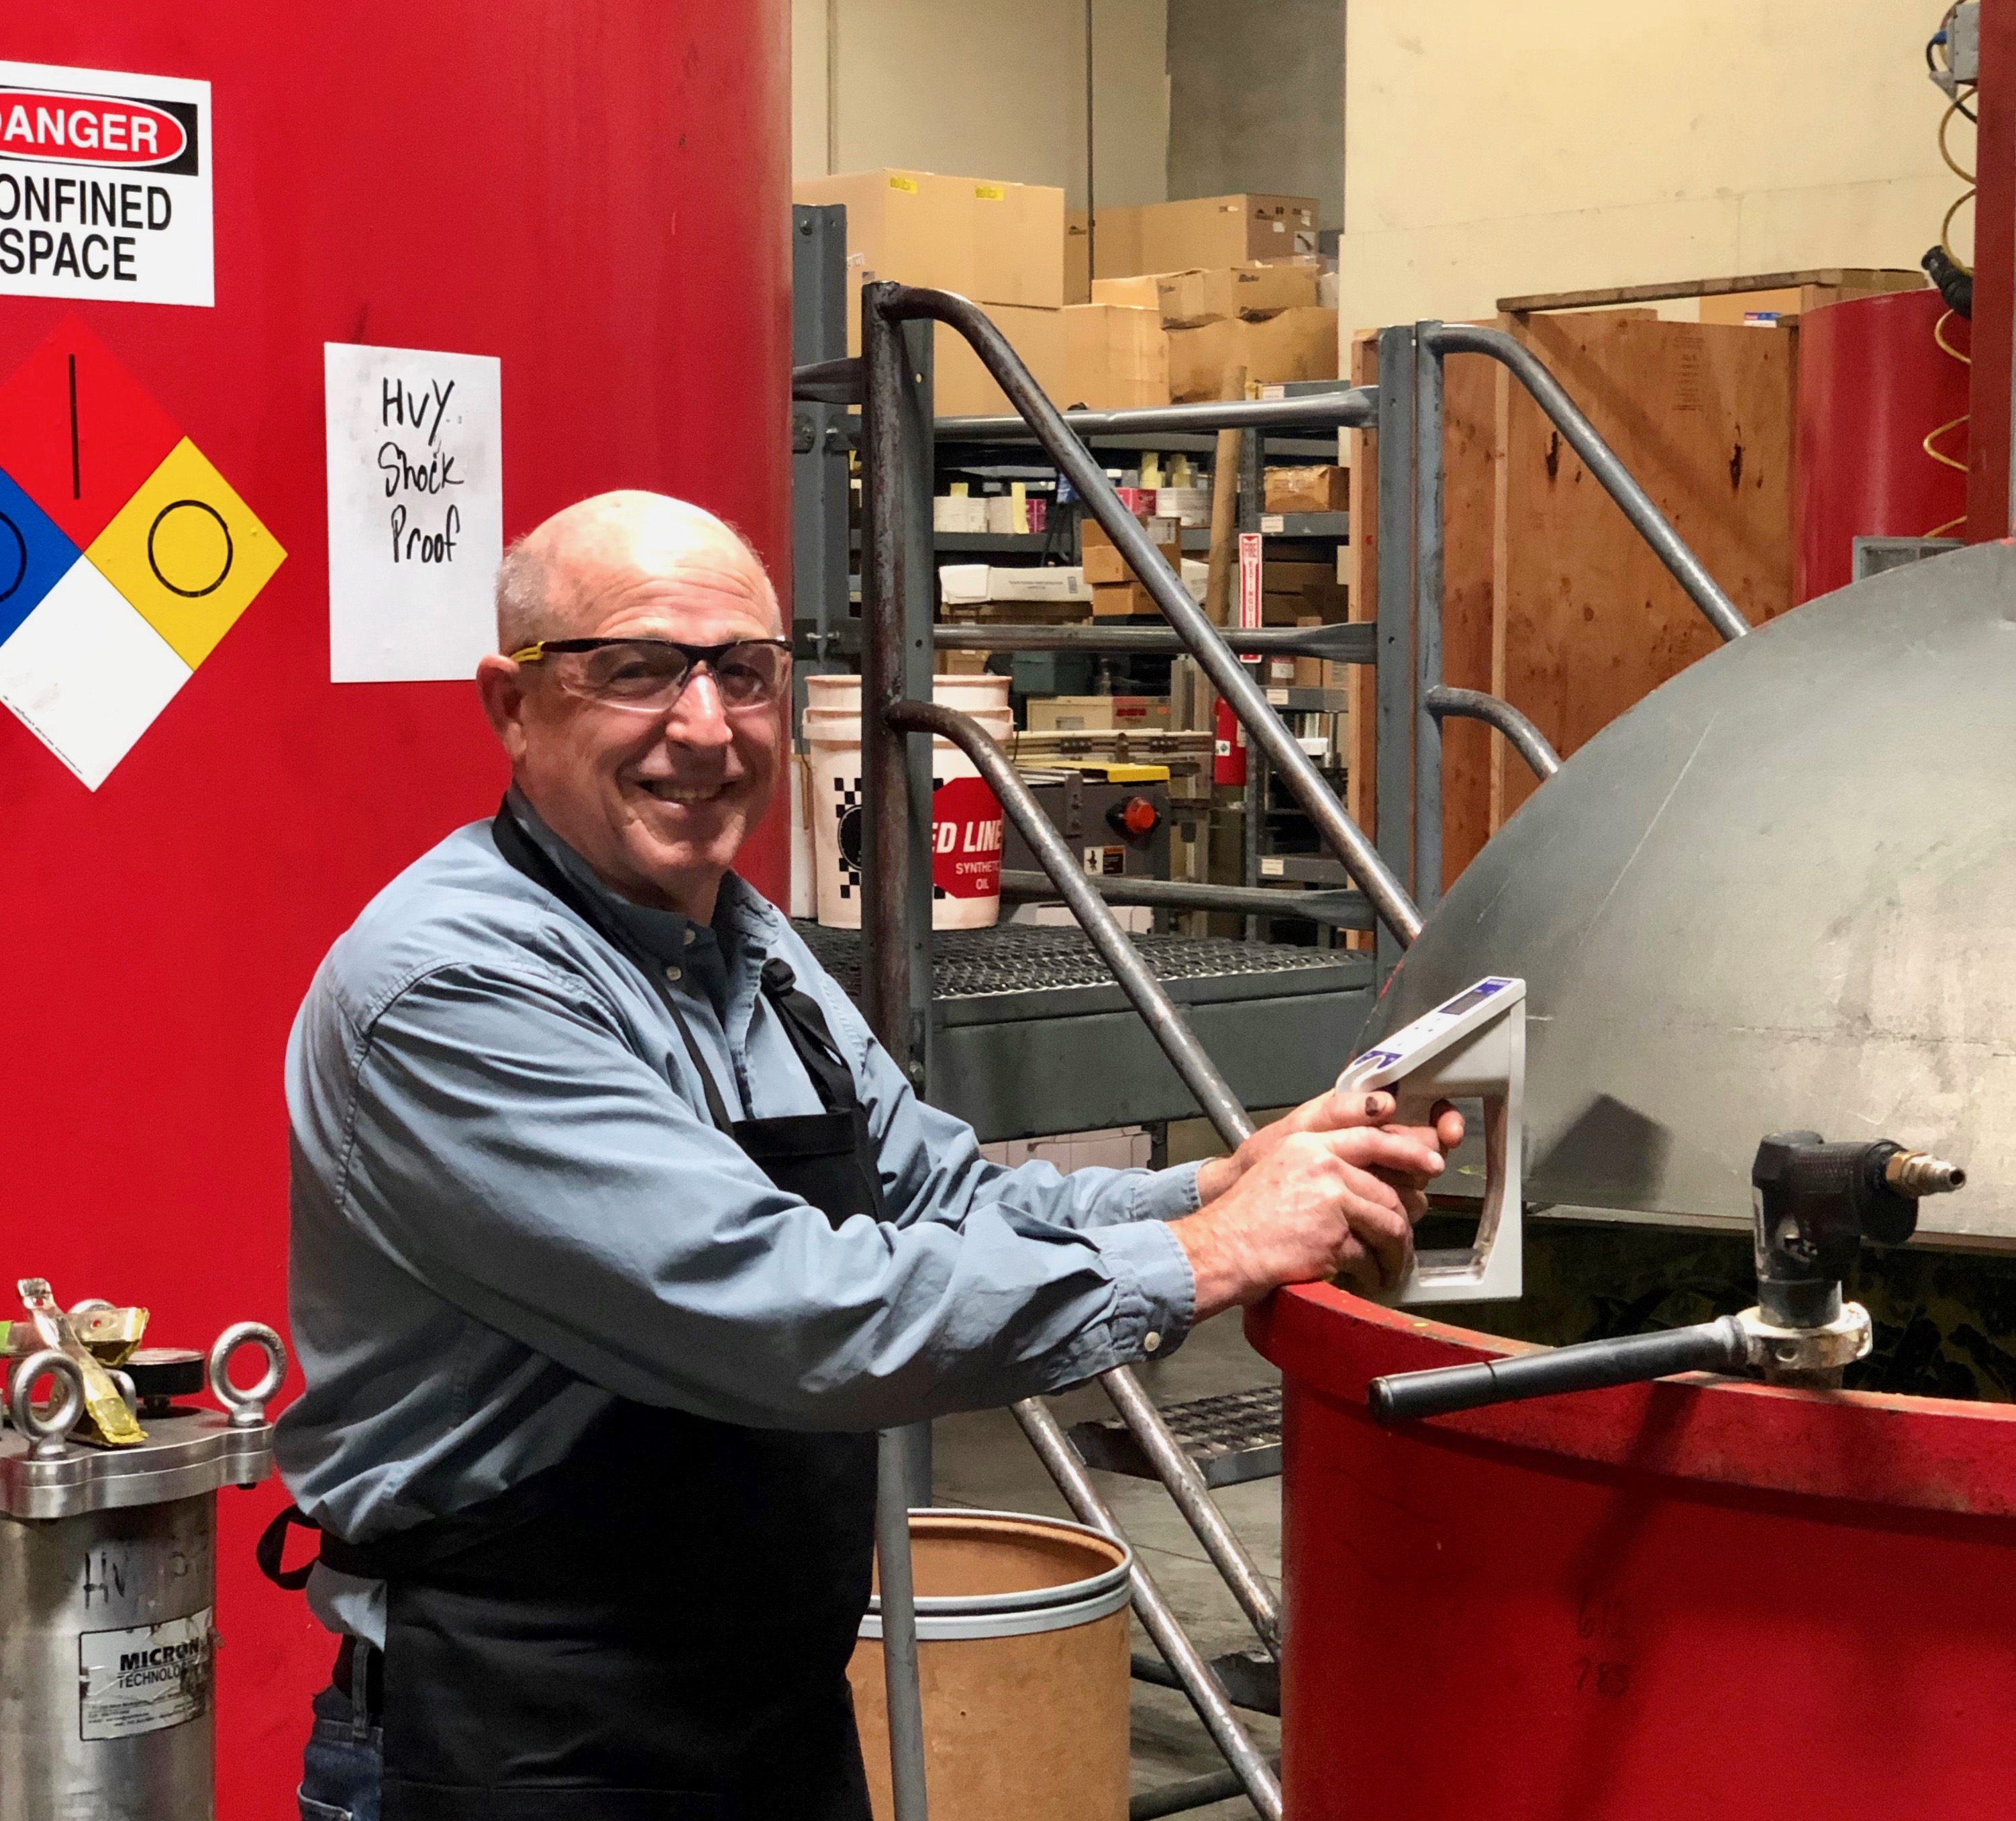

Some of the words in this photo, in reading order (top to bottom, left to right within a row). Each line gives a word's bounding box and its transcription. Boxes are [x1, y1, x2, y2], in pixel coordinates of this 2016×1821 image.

[0, 104, 158, 154] ANGER
[0, 173, 172, 231] ONFINED
[0, 228, 138, 282] SPACE
[383, 377, 456, 447] HVY
[377, 441, 464, 497] Shock
[391, 504, 460, 563] Proof
[932, 822, 958, 854] ED
[963, 820, 1001, 852] LINE
[955, 860, 1000, 875] SYNTHET
[975, 877, 991, 891] OIL
[119, 1636, 200, 1671] MICRON
